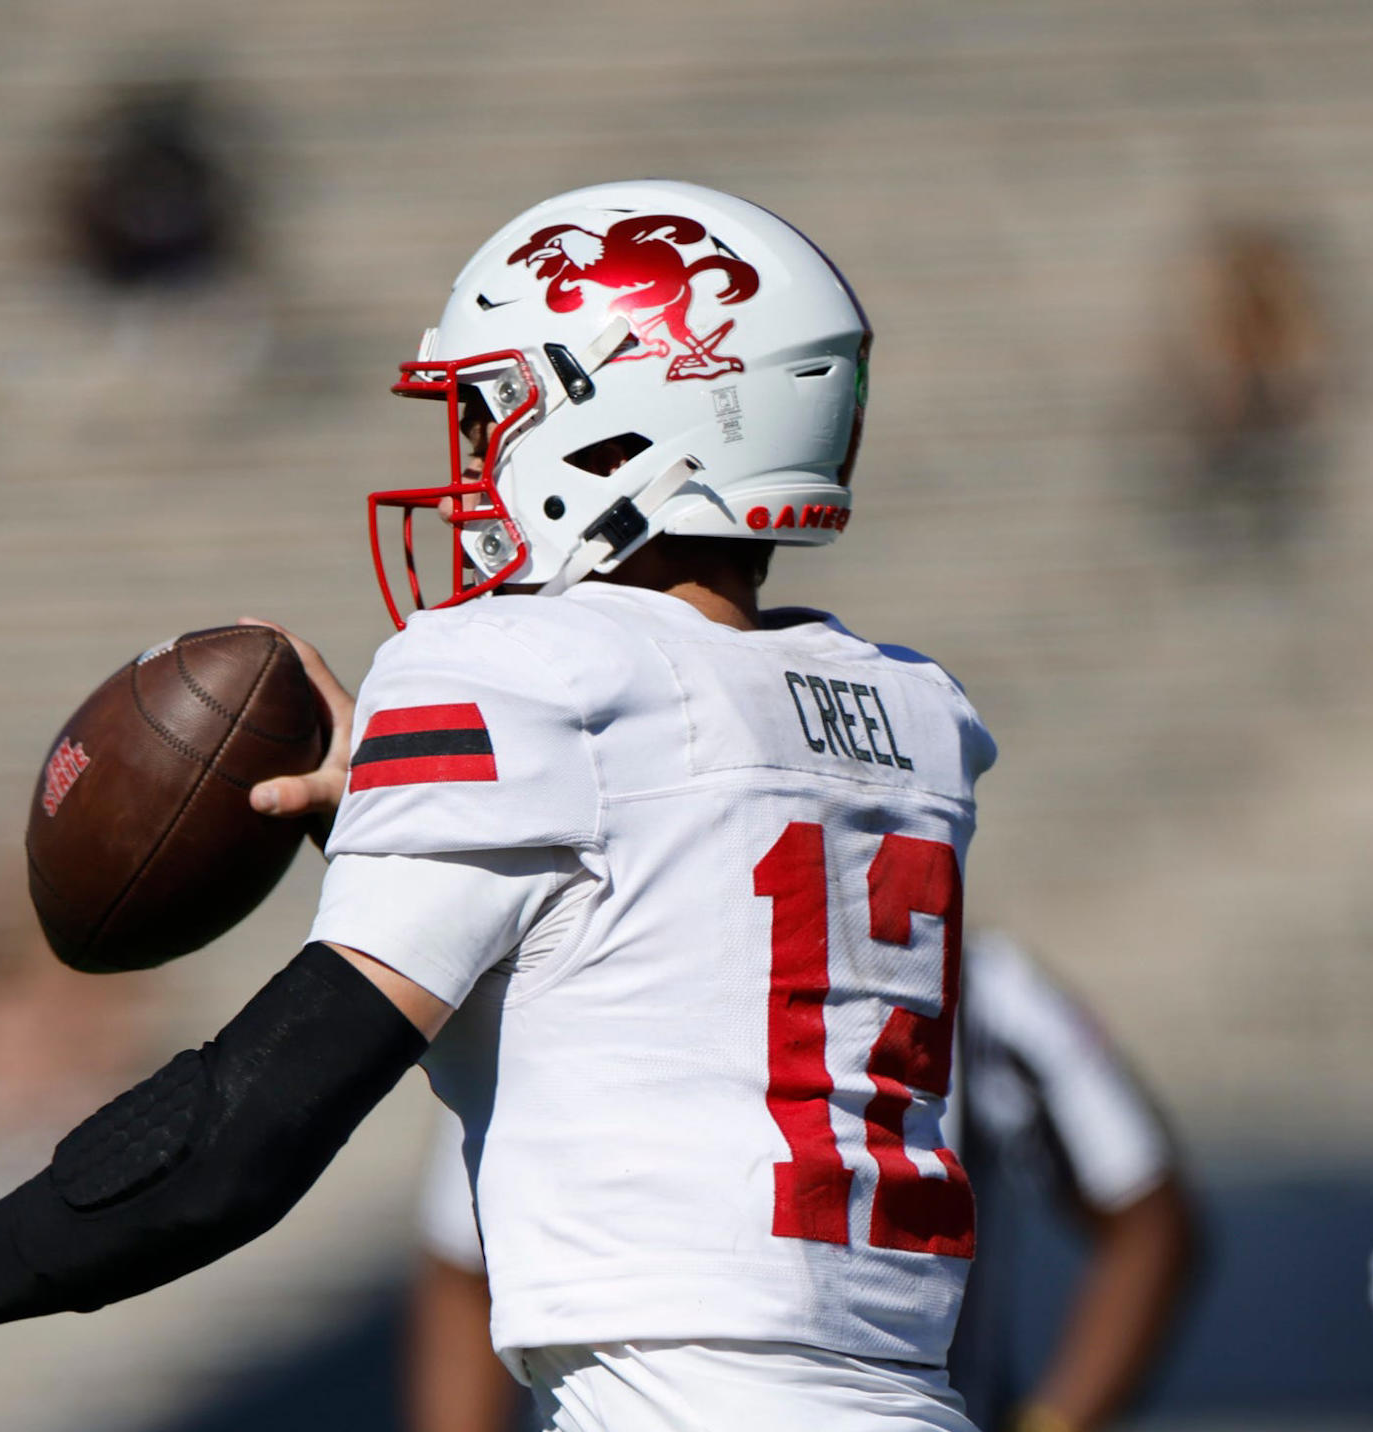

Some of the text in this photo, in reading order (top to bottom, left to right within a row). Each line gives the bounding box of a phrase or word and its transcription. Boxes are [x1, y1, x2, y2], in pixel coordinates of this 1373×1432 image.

[784, 670, 915, 772] CREEL
[42, 741, 91, 817] STATE
[752, 821, 976, 1260] 12
